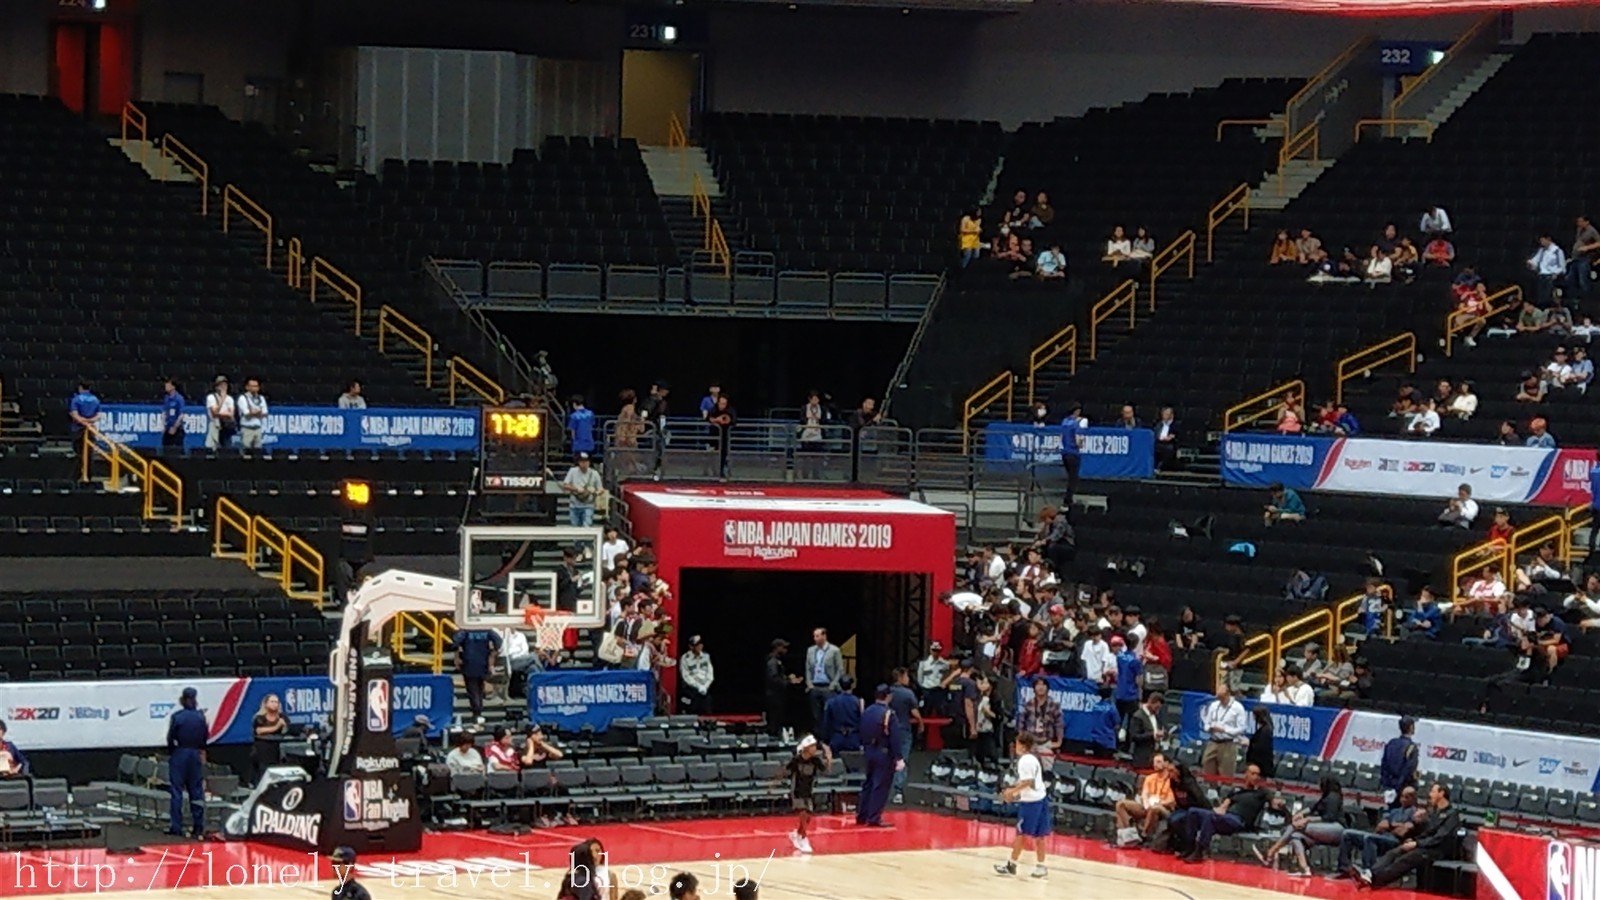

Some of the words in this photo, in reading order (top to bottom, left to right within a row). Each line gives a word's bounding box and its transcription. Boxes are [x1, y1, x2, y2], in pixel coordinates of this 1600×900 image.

[630, 24, 656, 38] 231
[1381, 48, 1411, 64] 232
[114, 412, 149, 433] JAPAN
[287, 414, 320, 435] GAMES
[320, 415, 344, 435] 2019
[369, 416, 389, 435] NBA
[390, 416, 420, 435] JAPAN
[421, 416, 452, 436] GAMES
[452, 416, 475, 437] 2019
[1104, 434, 1130, 455] 2019
[501, 476, 543, 487] TISSOT
[737, 520, 764, 545] NBA
[766, 521, 811, 546] JAPAN
[812, 522, 857, 548] GAMES
[858, 524, 892, 549] 2019
[753, 545, 798, 561] Rakuten
[296, 687, 322, 713] NBA
[402, 685, 432, 710] 2019
[14, 706, 60, 721] 2K20
[1287, 714, 1312, 742] 2019
[356, 756, 400, 773] Rakuten
[1432, 745, 1468, 763] 2K20
[363, 779, 384, 800] NBA
[363, 800, 382, 820] Fan
[382, 798, 410, 823] Night
[251, 803, 322, 846] SPALDING
